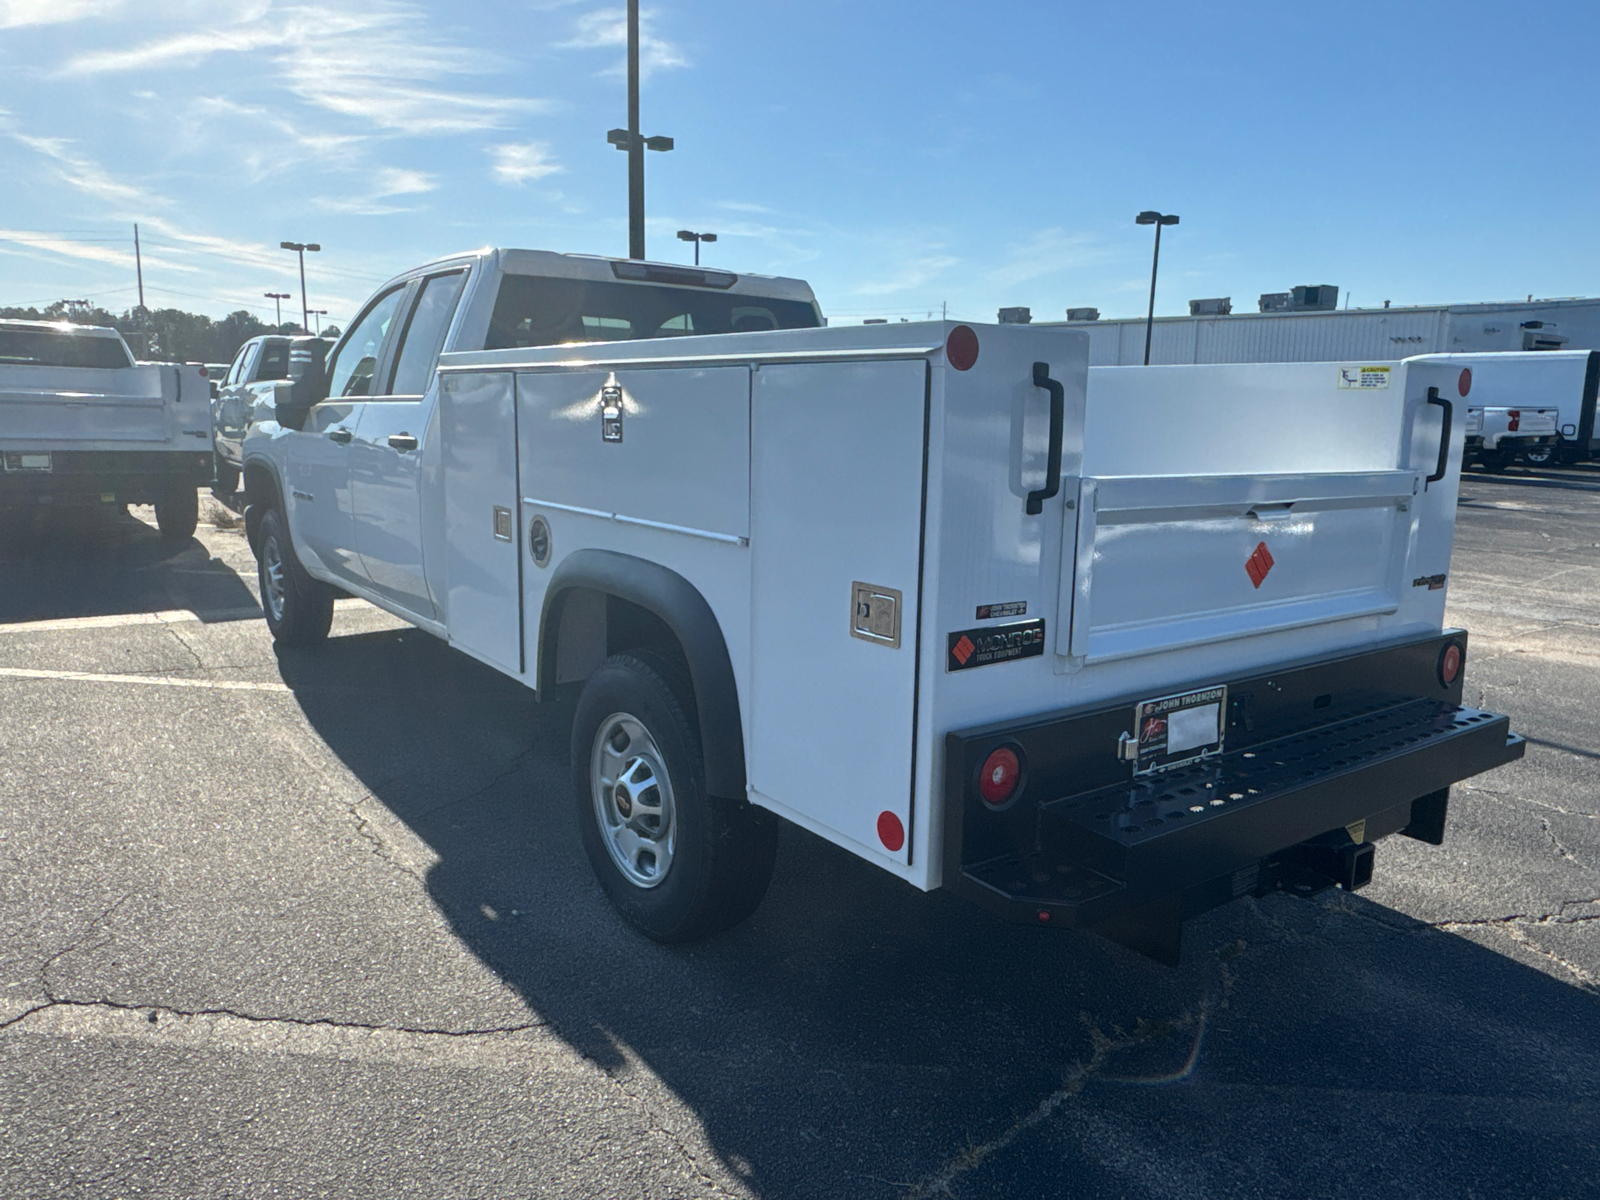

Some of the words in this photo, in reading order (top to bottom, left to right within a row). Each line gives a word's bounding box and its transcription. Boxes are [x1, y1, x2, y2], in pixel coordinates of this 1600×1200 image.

[990, 609, 1017, 618] CHEVROLET
[976, 628, 1043, 654] MONROE
[976, 652, 994, 662] TRUCK
[994, 647, 1022, 659] EQUIPMENT
[1155, 698, 1180, 713] JOHN
[1181, 688, 1223, 705] THORNTON
